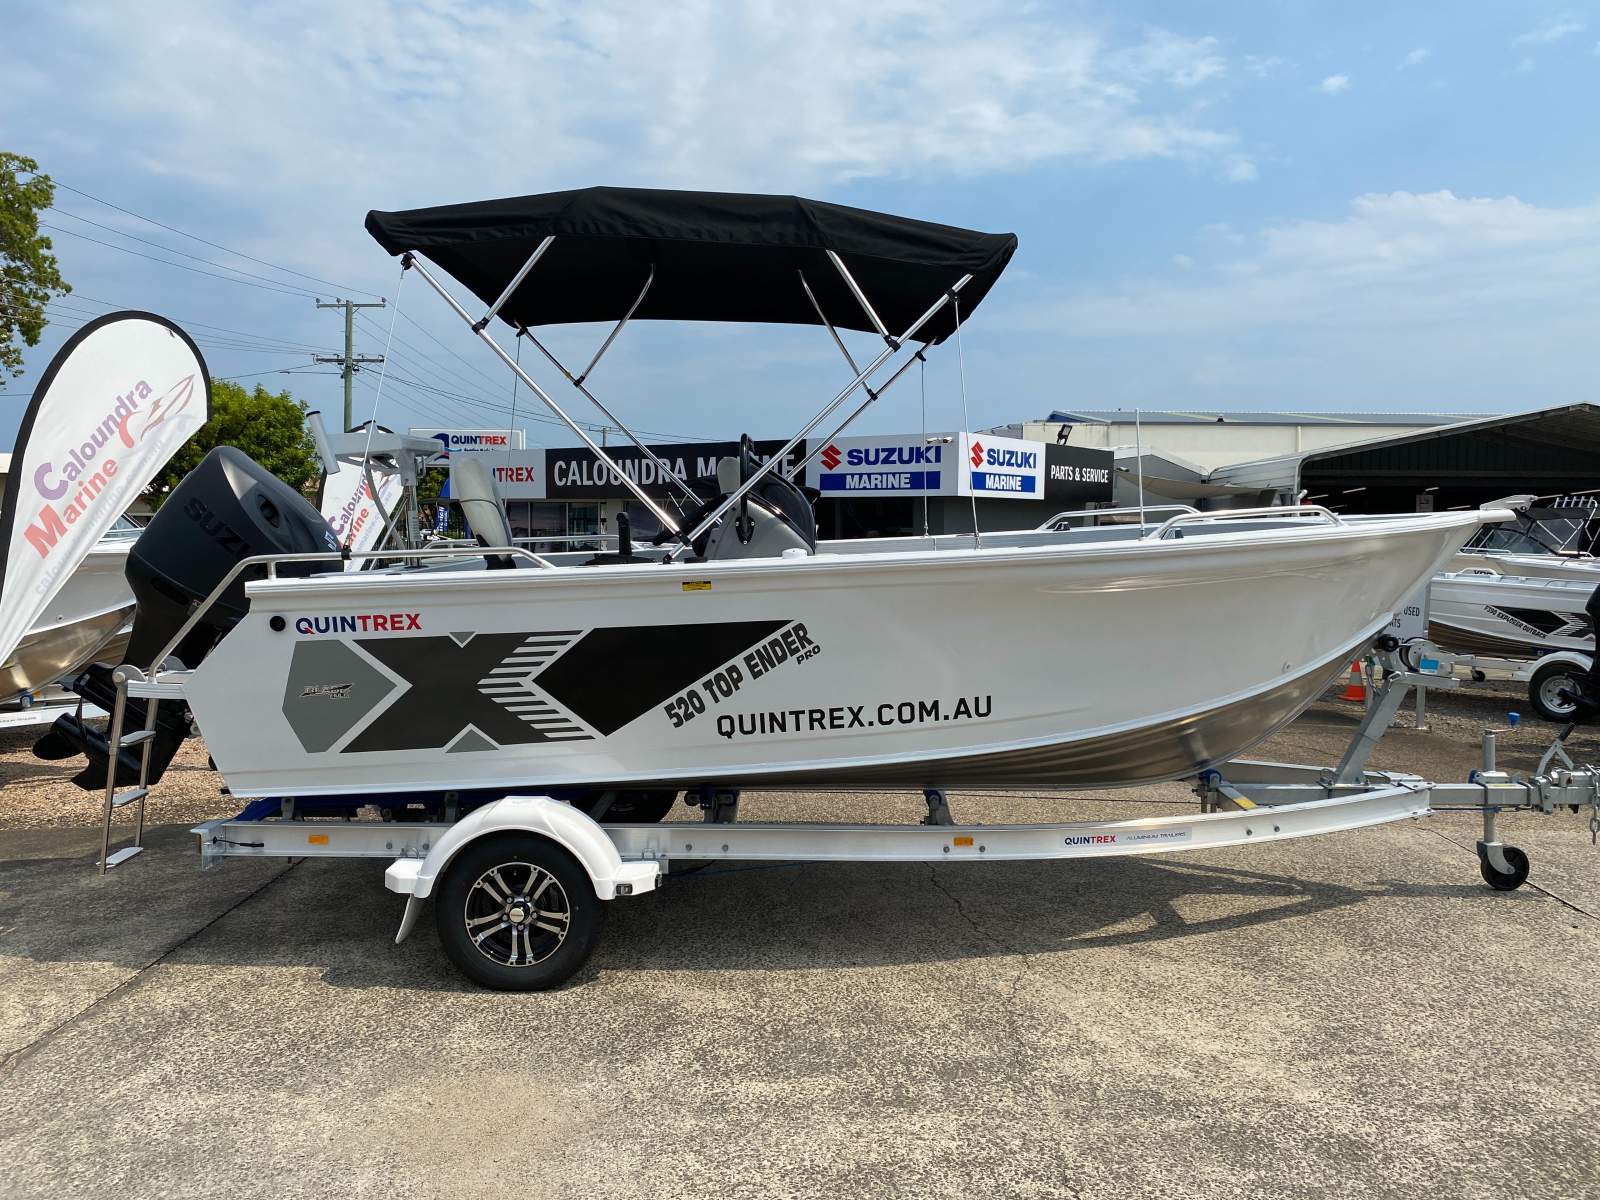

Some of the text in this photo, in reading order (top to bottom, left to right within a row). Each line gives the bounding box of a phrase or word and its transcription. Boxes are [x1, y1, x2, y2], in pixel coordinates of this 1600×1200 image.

[34, 380, 151, 501] Caloundra
[451, 435, 507, 445] QUINTREX
[847, 446, 941, 466] SUZUKI
[986, 448, 1037, 469] SUZUKI
[554, 458, 687, 486] CALOUNDRA
[845, 473, 911, 490] MARINE
[1050, 464, 1109, 483] PARTS & SERVICE
[985, 475, 1022, 491] MARINE
[24, 458, 118, 559] Marine
[1403, 606, 1420, 617] USED
[295, 613, 423, 635] QUINTREX
[796, 644, 821, 665] PRO
[664, 622, 815, 728] 520 TOP ENDER
[716, 695, 993, 739] QUINTREX.COM.AU
[1064, 835, 1117, 846] QUINTREX
